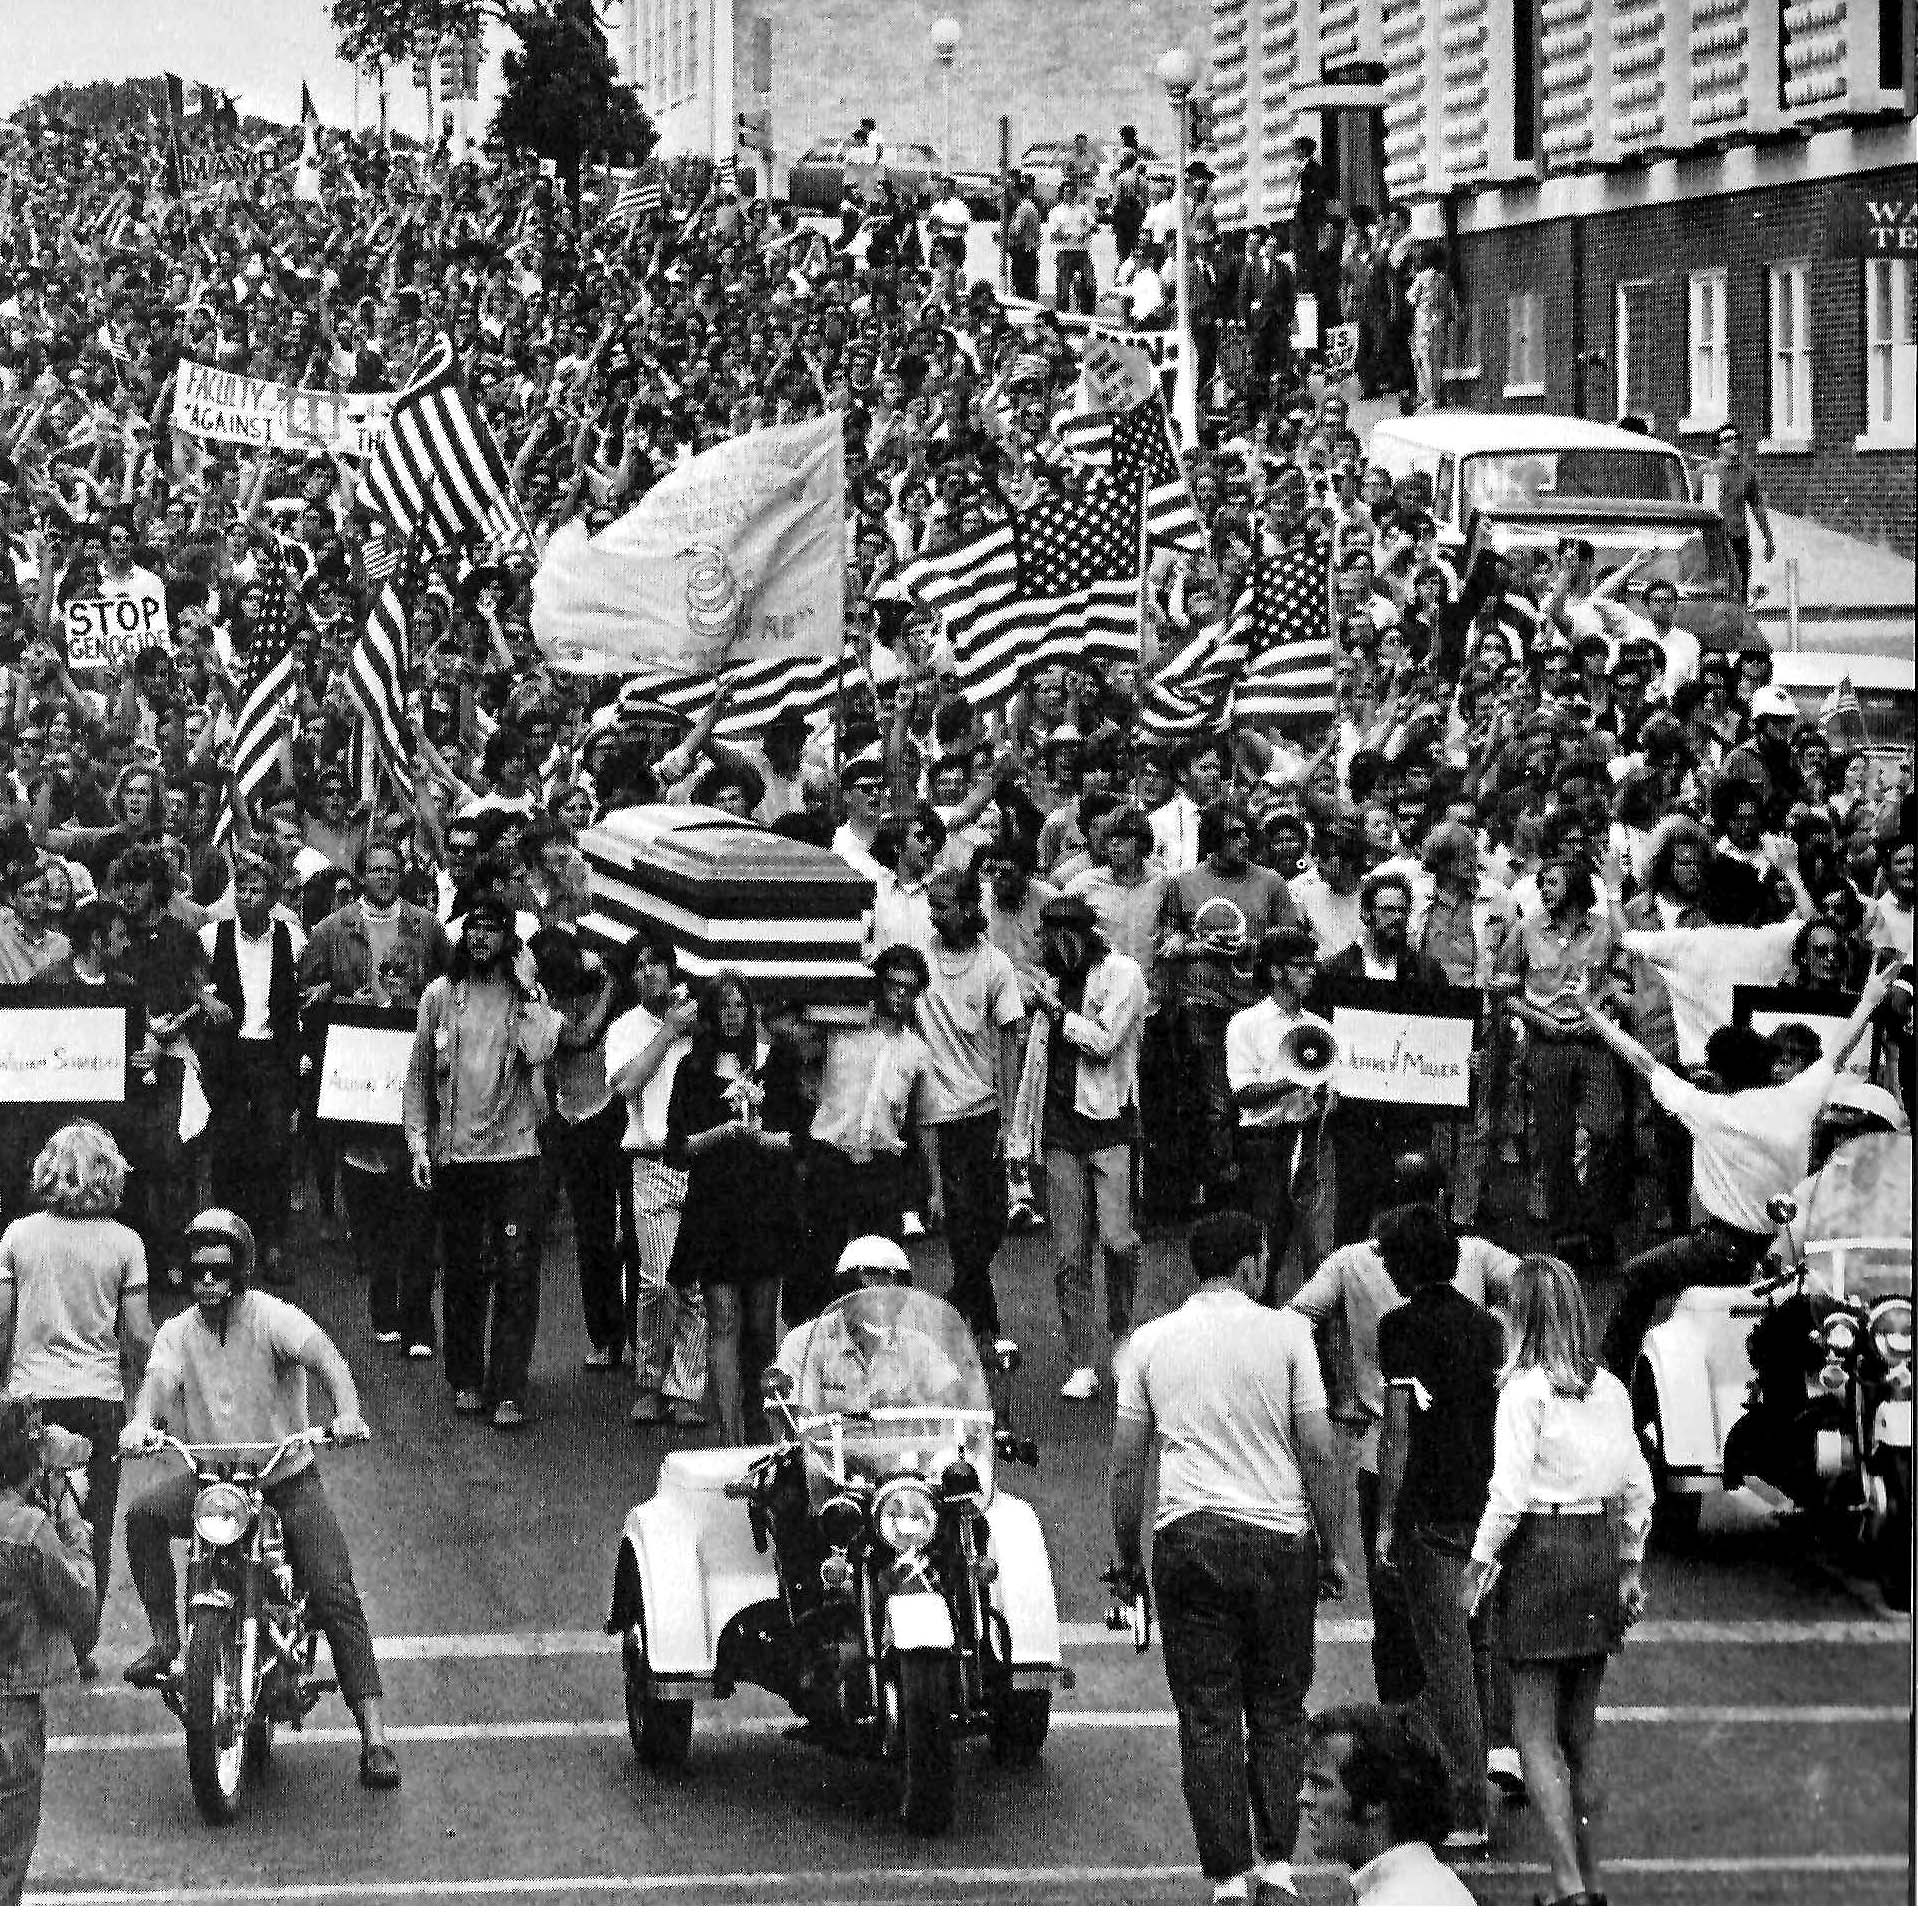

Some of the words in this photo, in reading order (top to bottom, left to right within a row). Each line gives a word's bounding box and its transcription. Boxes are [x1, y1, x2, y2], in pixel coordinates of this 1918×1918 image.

[1868, 226, 1917, 249] TE
[186, 363, 267, 410] FACULTY
[189, 403, 272, 446] AGAINST
[69, 595, 160, 636] STOP
